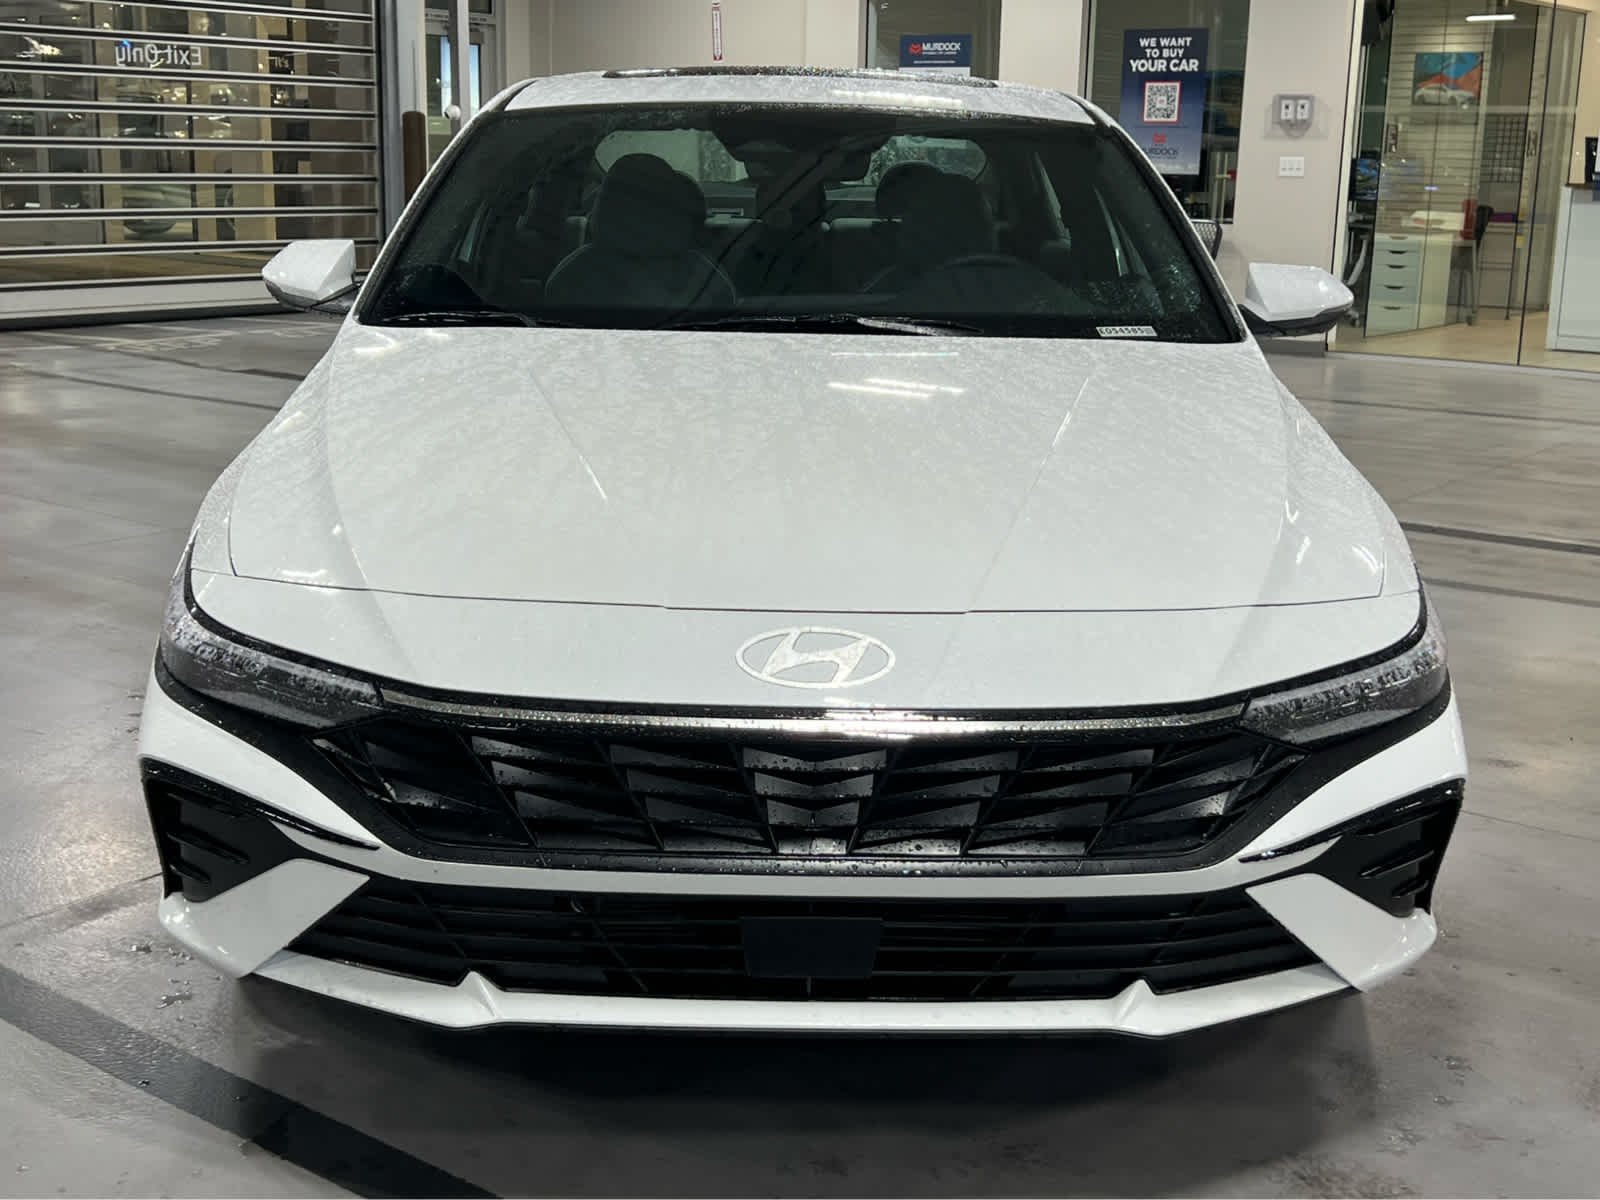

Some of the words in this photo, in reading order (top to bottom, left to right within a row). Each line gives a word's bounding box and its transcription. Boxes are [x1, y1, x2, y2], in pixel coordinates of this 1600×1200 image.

[1139, 37, 1157, 47] WE
[1160, 37, 1192, 47] WANT
[1145, 48, 1160, 58] TO
[1162, 48, 1184, 58] BUY
[1129, 59, 1167, 72] YOUR
[1169, 59, 1199, 72] CAR
